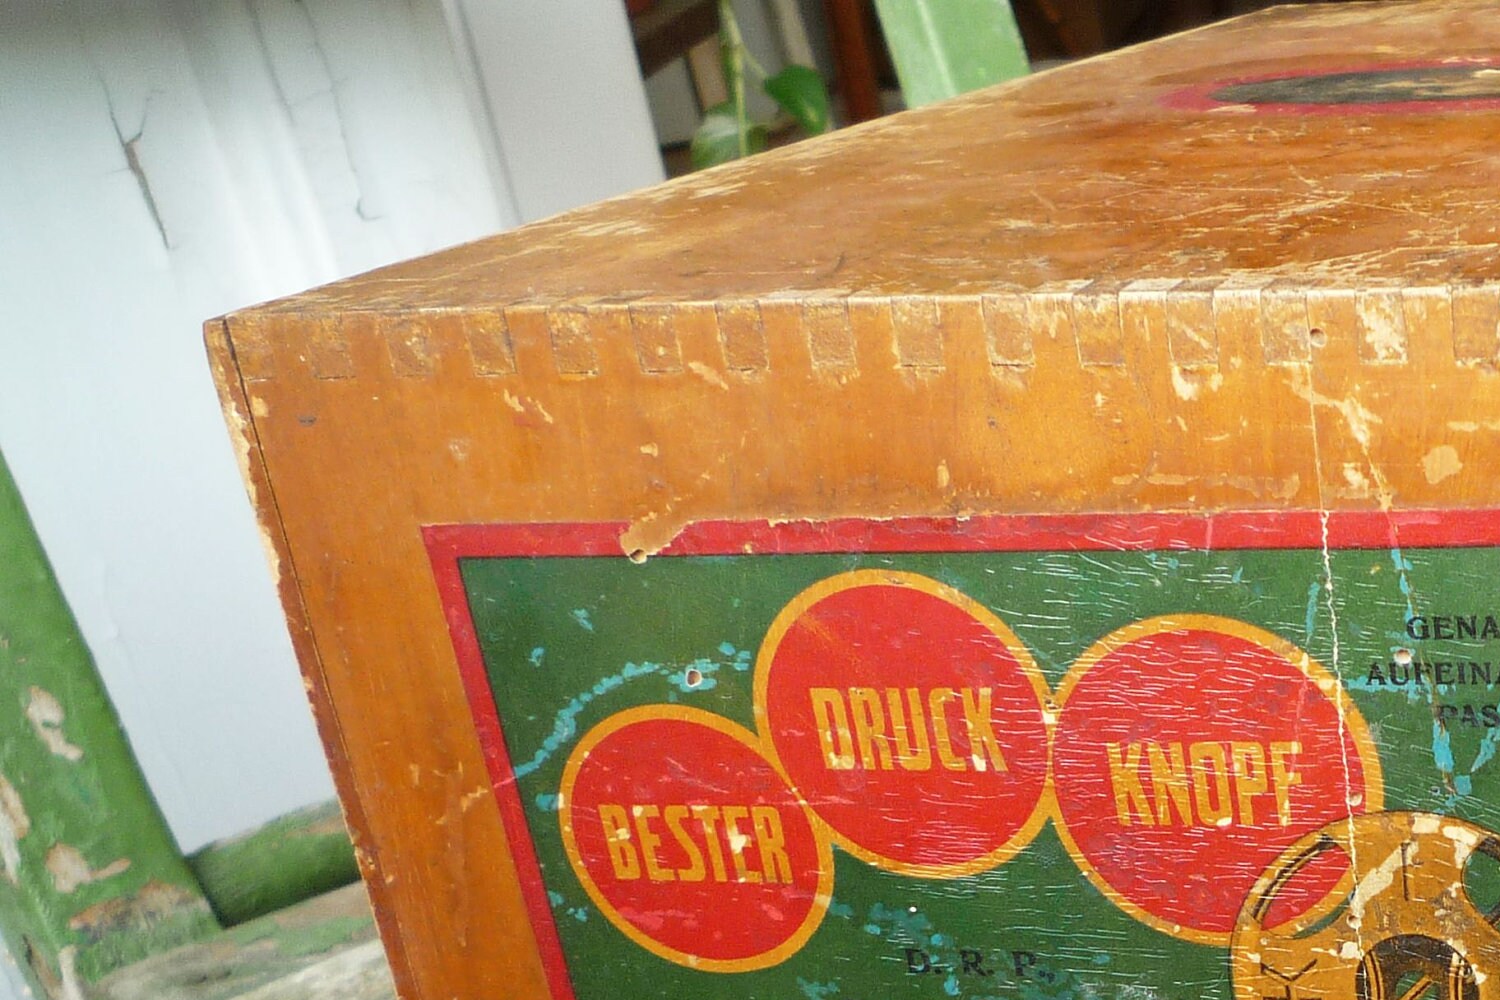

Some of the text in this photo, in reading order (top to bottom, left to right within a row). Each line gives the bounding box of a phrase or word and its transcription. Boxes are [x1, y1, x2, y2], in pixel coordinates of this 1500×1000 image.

[597, 686, 1303, 884] BESTER DRUCK KNOPF
